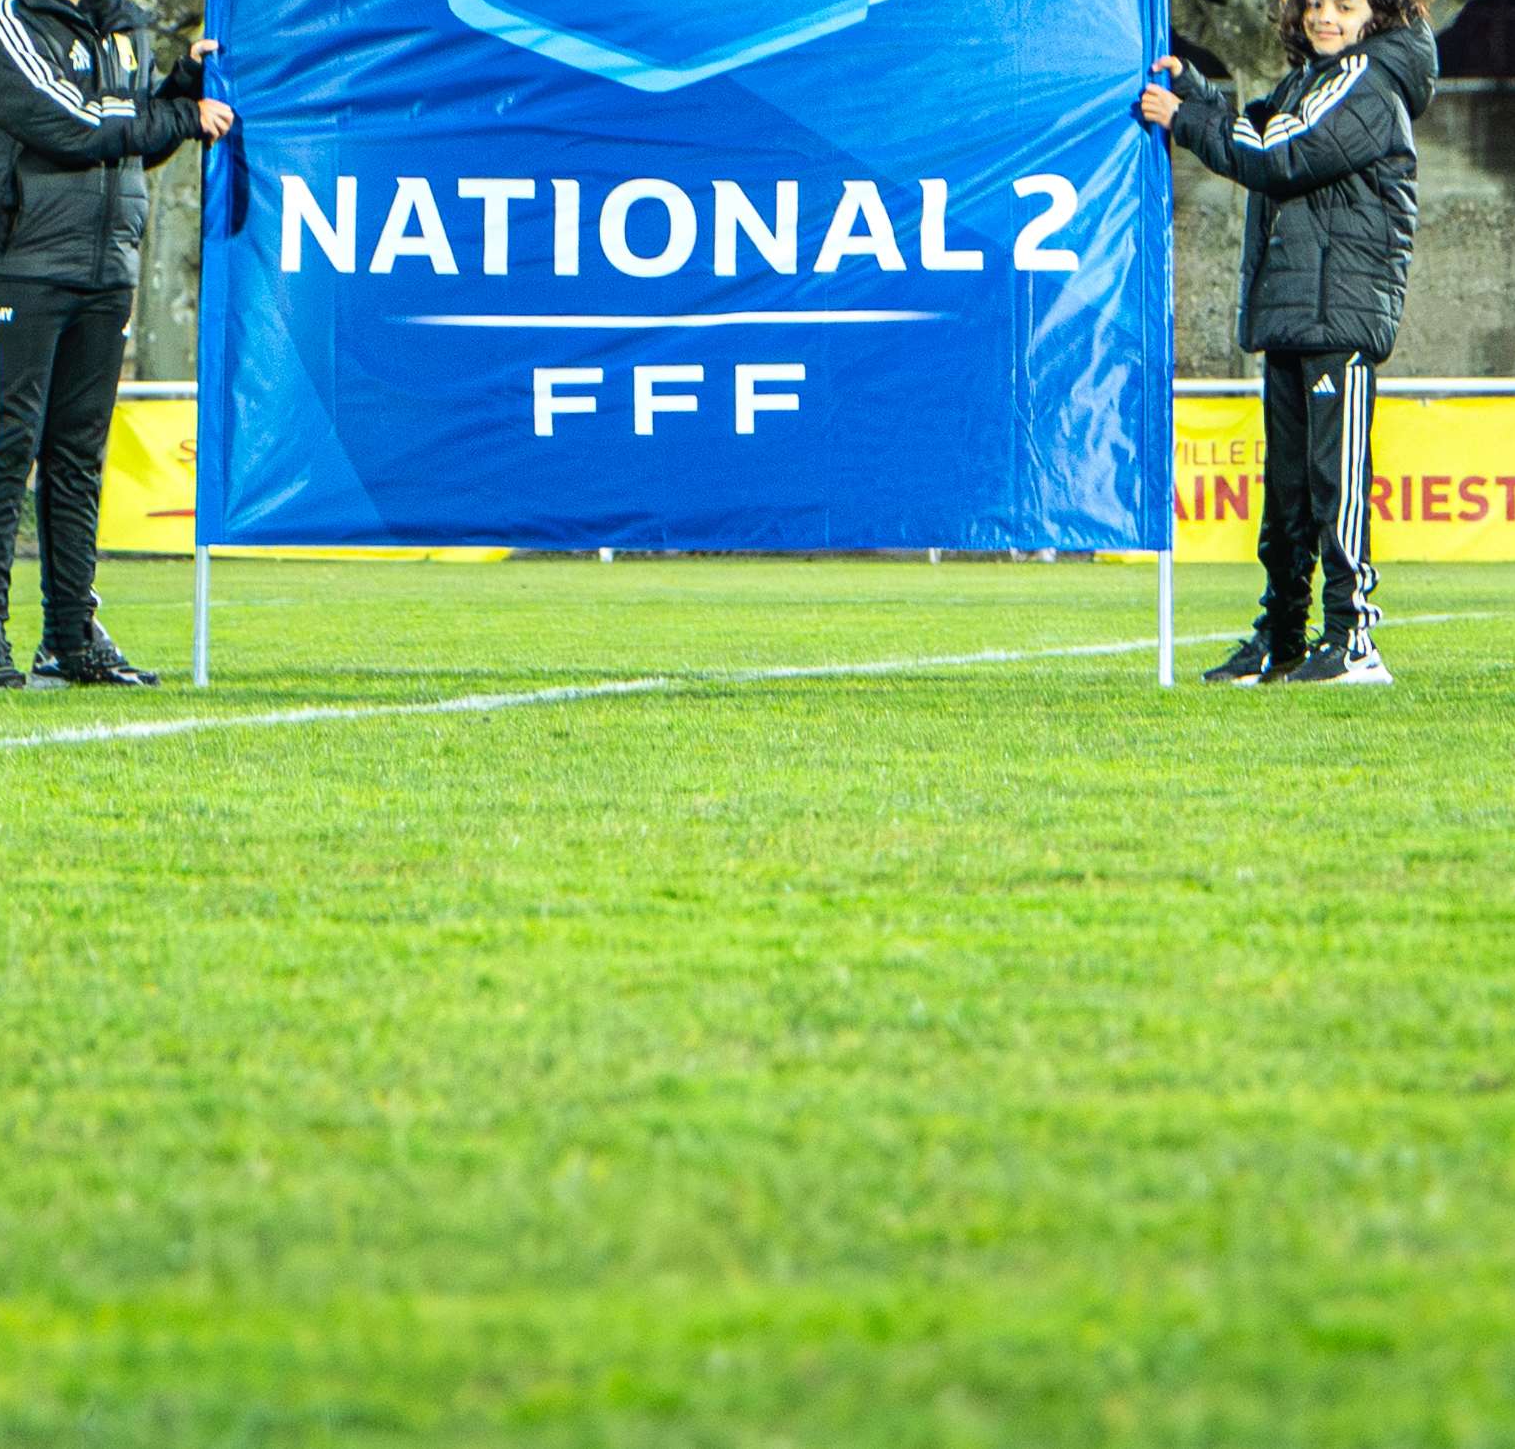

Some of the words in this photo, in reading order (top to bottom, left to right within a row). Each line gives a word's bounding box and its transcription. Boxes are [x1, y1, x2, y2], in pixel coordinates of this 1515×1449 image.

[281, 174, 983, 275] NATIONAL
[1013, 173, 1079, 271] 2
[534, 363, 806, 437] FFF
